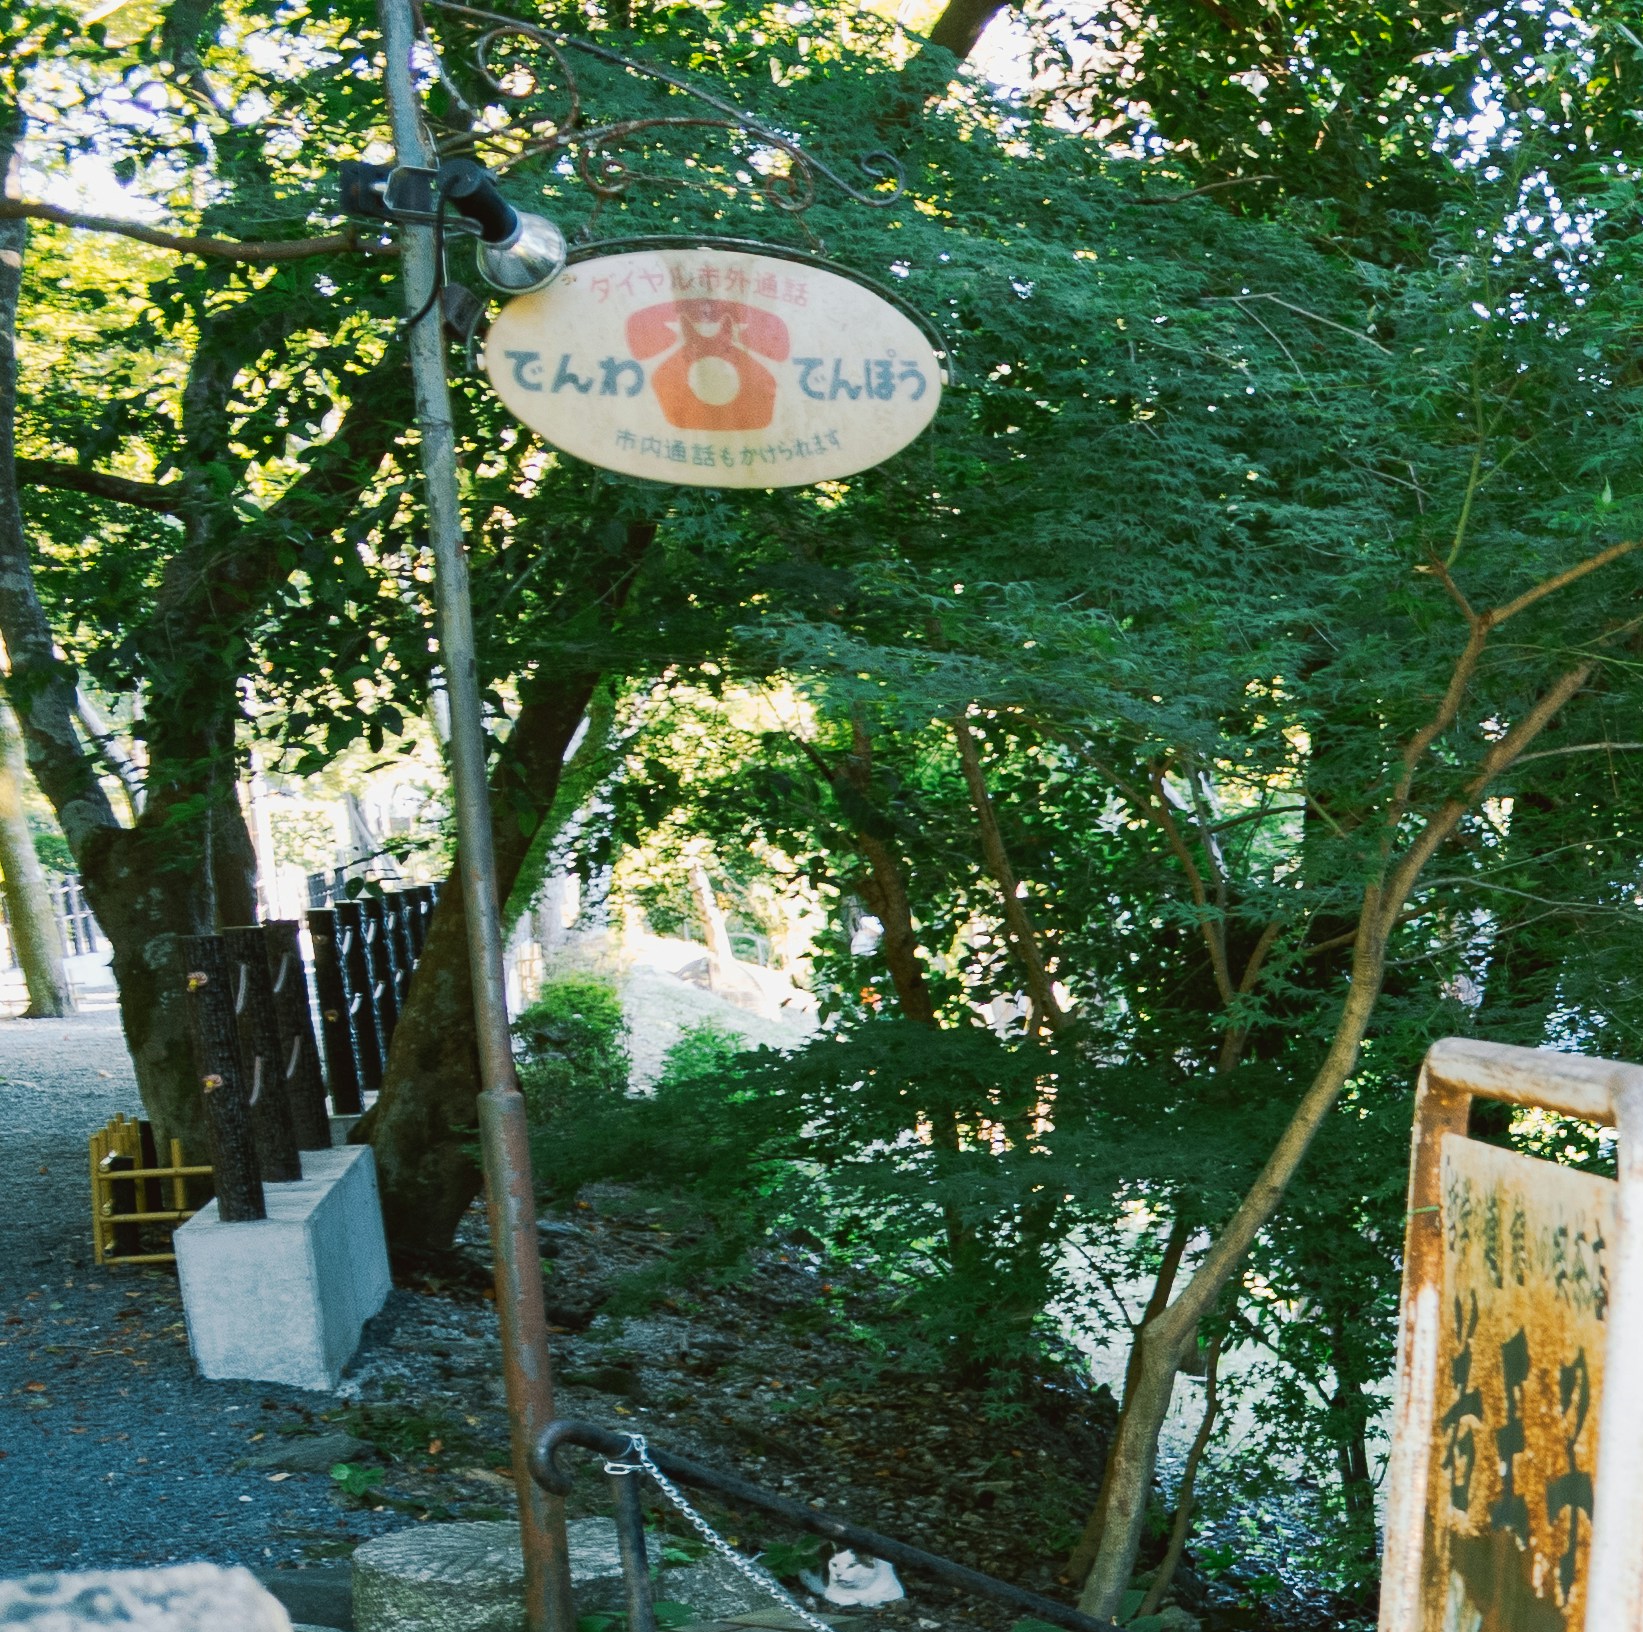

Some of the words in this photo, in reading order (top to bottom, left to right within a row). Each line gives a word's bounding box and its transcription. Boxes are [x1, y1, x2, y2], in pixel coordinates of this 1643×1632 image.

[592, 264, 810, 306] ダイヤル市外通話
[505, 350, 645, 396] でんわ
[792, 349, 927, 401] でんぽう
[615, 428, 841, 468] 市内通話もかけられます
